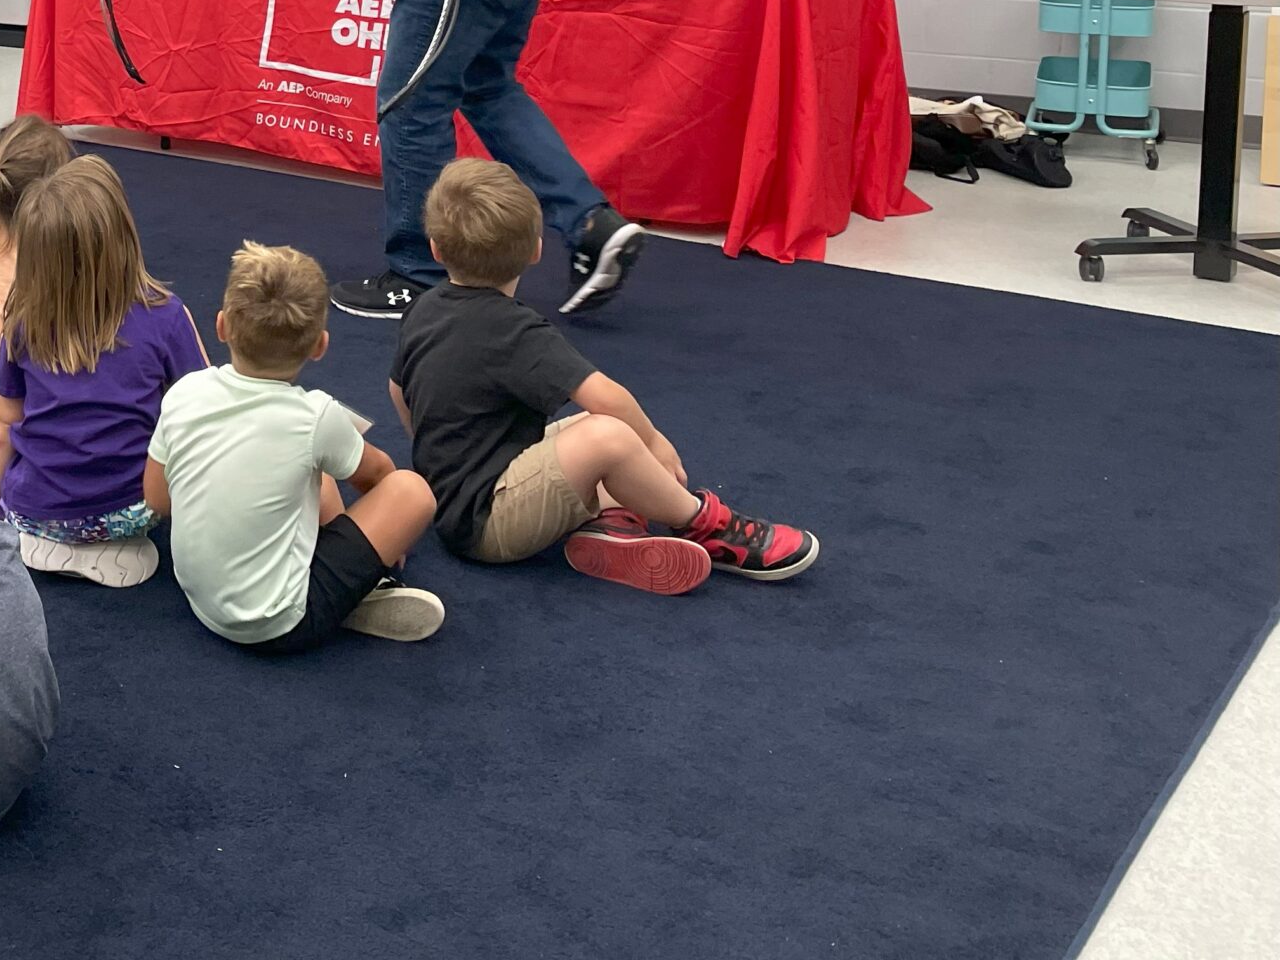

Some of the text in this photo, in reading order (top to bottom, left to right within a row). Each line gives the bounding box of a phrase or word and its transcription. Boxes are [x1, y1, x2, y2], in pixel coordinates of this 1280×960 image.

[257, 78, 353, 109] An AEP Company
[255, 112, 354, 143] BOUNDLESS
